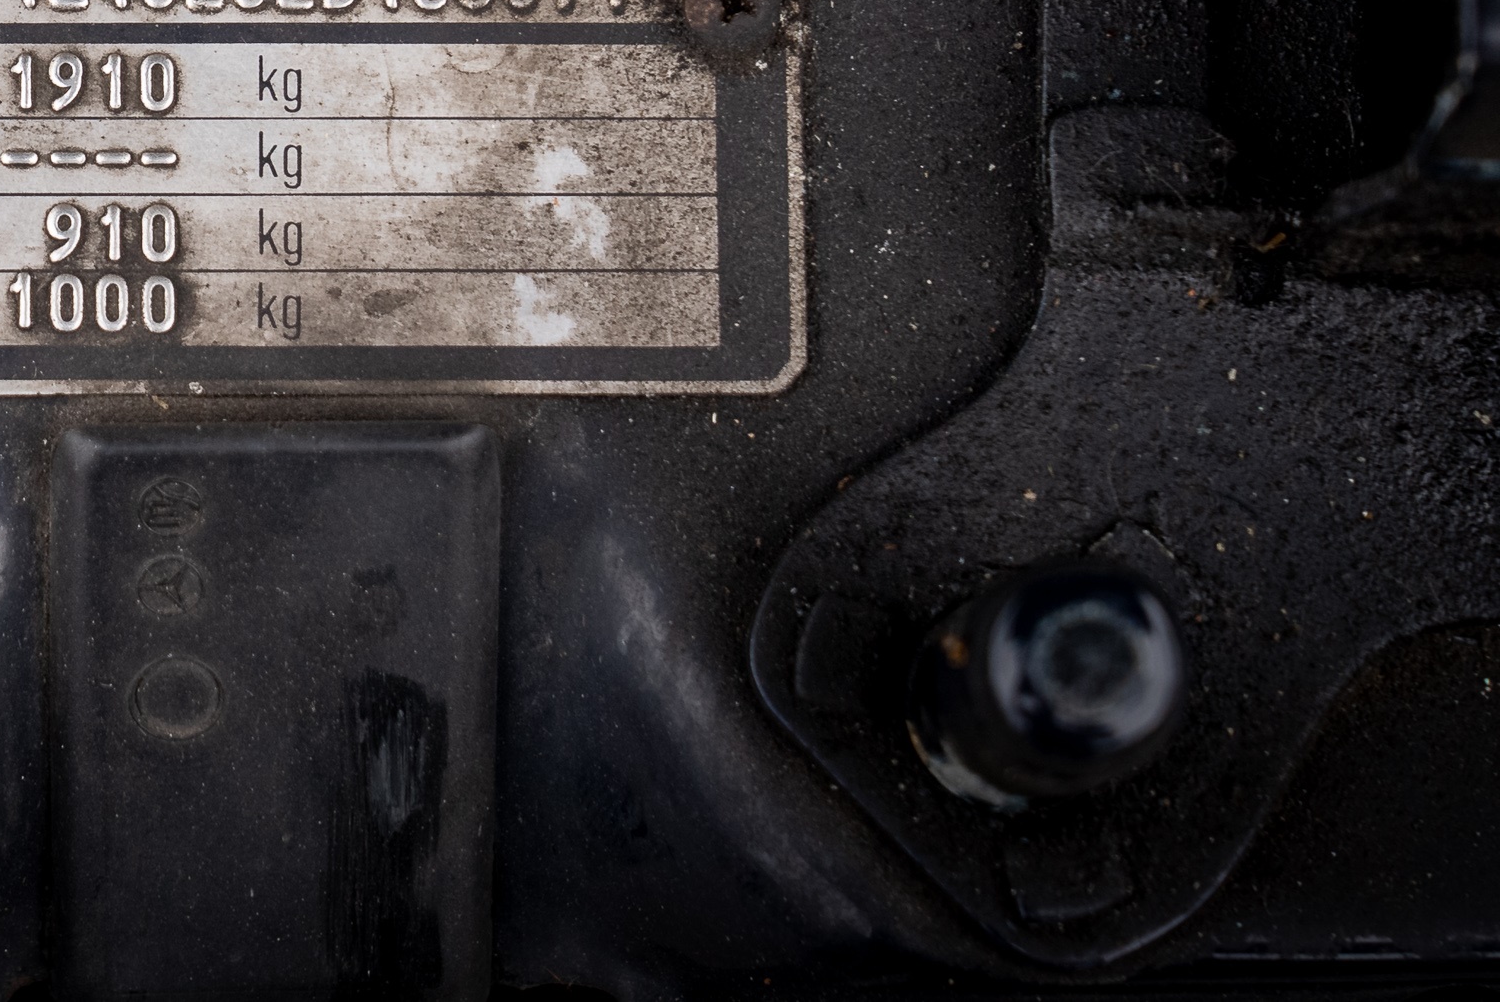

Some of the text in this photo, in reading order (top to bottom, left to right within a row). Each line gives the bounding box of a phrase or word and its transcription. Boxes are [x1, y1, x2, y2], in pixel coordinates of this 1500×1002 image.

[10, 52, 302, 113] 1910 kg
[258, 131, 302, 189] kg
[46, 203, 179, 263] 910
[258, 208, 302, 266] kg
[10, 271, 177, 332] 1000
[258, 283, 302, 339] kg
